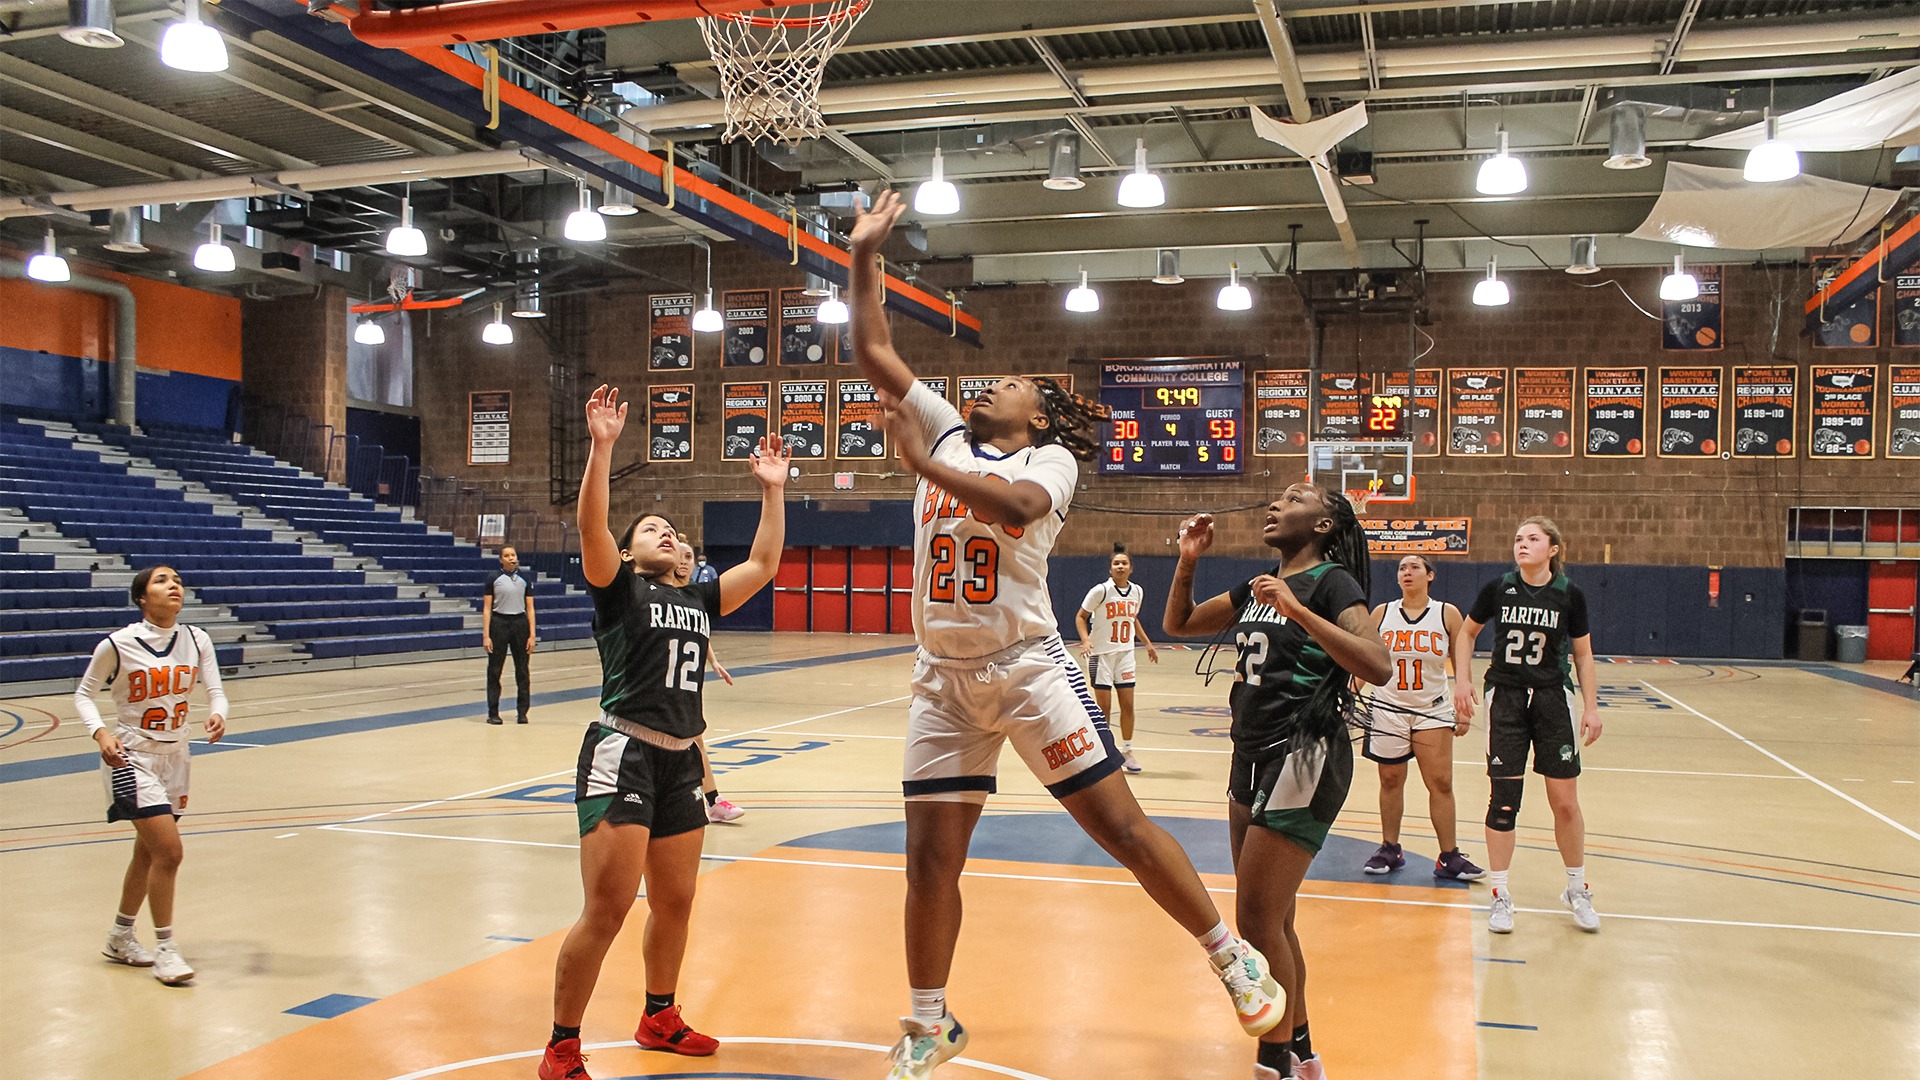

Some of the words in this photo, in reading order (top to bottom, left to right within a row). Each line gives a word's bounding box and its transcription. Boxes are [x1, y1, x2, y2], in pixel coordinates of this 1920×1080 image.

[1681, 303, 1702, 312] 2013
[1115, 373, 1178, 383] COMMUNITY
[1180, 372, 1229, 381] COLLEGE
[1452, 371, 1503, 379] NATIONAL
[1815, 368, 1873, 378] NATIONAL
[1257, 388, 1291, 396] REGION
[1294, 388, 1307, 396] XV
[1424, 387, 1438, 395] XV
[1452, 386, 1503, 394] TOURNAMENT
[1588, 386, 1643, 395] C.U.N.Y.A.C.
[1662, 386, 1718, 395] C.U.N.Y.A.C.
[1778, 386, 1793, 395] XV
[1815, 384, 1872, 393] TOURNAMENT
[794, 394, 813, 403] 2000
[853, 393, 871, 401] 1999
[1156, 387, 1199, 406] 9:49
[725, 399, 754, 407] REGION
[755, 399, 767, 407] XV
[1258, 398, 1307, 410] CHAMPIONS
[1519, 398, 1570, 410] CHAMPIONS
[1588, 397, 1642, 409] CHAMPIONS
[1663, 397, 1717, 409] CHAMPIONS
[725, 408, 767, 420] CHAMPIONS
[1111, 411, 1136, 419] HOME
[1206, 409, 1233, 418] GUEST
[1264, 409, 1300, 418] 1992-93
[1369, 408, 1397, 430] 22
[781, 415, 824, 426] CHAMPIONS
[1821, 417, 1864, 427] 1999-00
[736, 426, 755, 434] 2000
[1114, 420, 1139, 440] 30
[1165, 423, 1177, 436] 4
[1209, 420, 1236, 439] 53
[1826, 443, 1854, 453] 28-5
[1112, 447, 1124, 462] 0
[1132, 446, 1144, 462] 2
[1197, 446, 1209, 462] 5
[1223, 446, 1236, 462] 0
[1390, 520, 1419, 530] OF
[1423, 520, 1466, 530] THE
[1367, 536, 1447, 551] NTHERS
[930, 533, 999, 604] 23
[1500, 606, 1560, 629] RARITAN
[1110, 620, 1131, 643] 10
[1505, 629, 1547, 666] 23
[665, 638, 700, 692] 12
[1397, 658, 1423, 690] 11
[1041, 727, 1094, 771] BMCC
